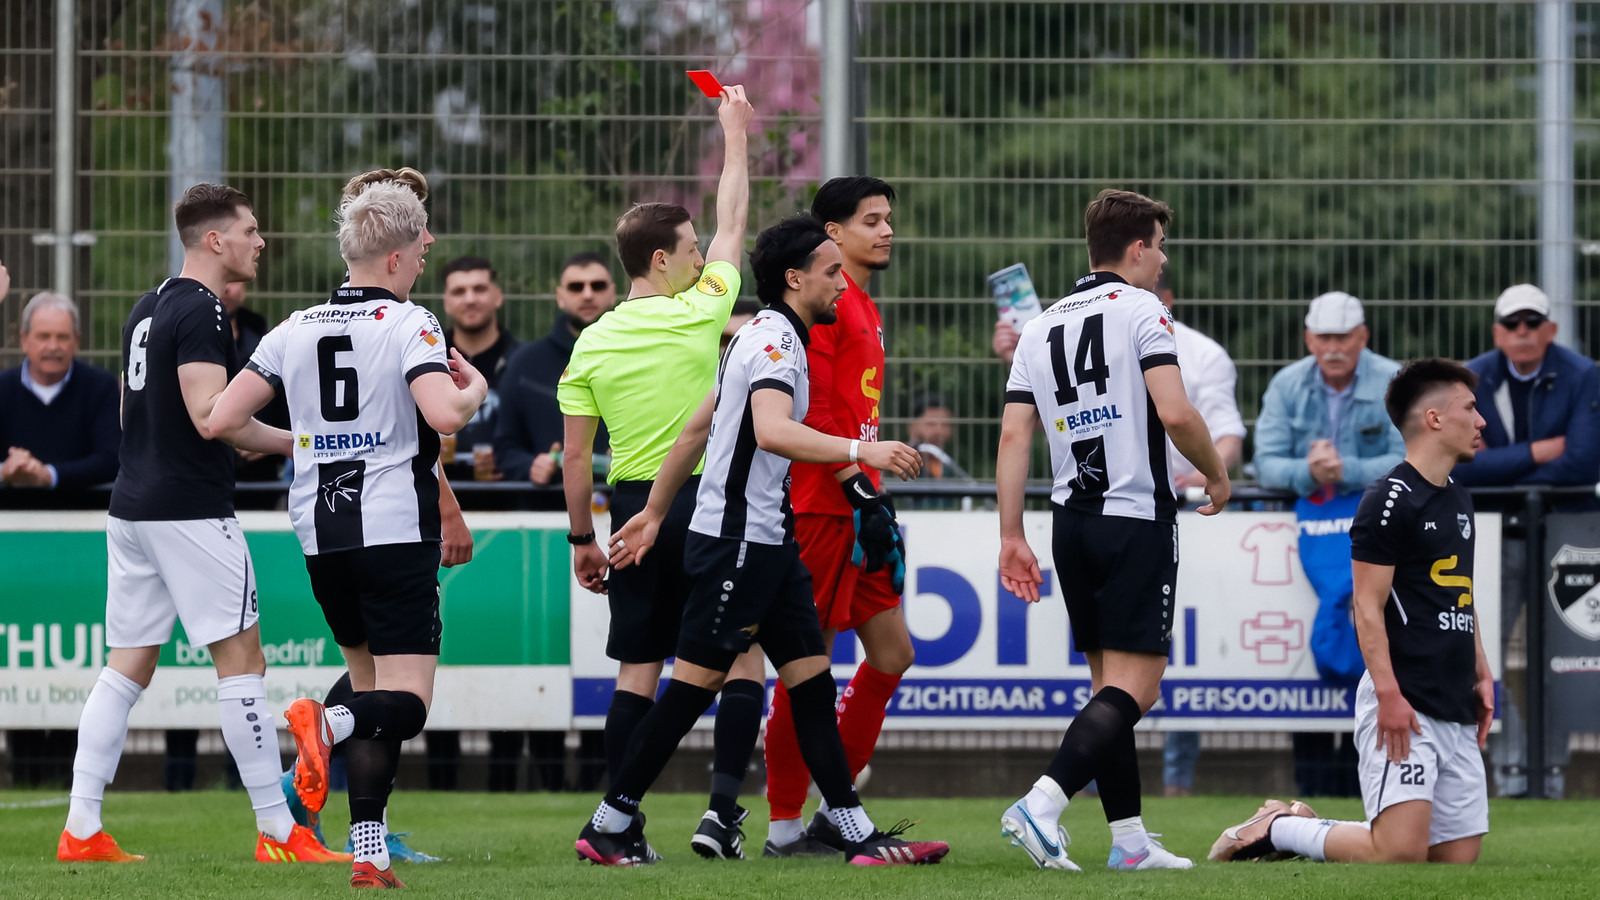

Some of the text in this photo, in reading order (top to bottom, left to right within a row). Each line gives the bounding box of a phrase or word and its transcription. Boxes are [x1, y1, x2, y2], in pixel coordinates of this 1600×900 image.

[128, 317, 153, 391] 6
[1046, 313, 1110, 406] 14
[317, 335, 359, 422] 6
[314, 431, 386, 450] BERDAL
[251, 590, 258, 612] 6
[1438, 607, 1474, 633] siers
[898, 686, 1045, 711] ZICHTBAAR
[1172, 687, 1348, 711] PERSOONLIJK
[1400, 763, 1425, 785] 22
